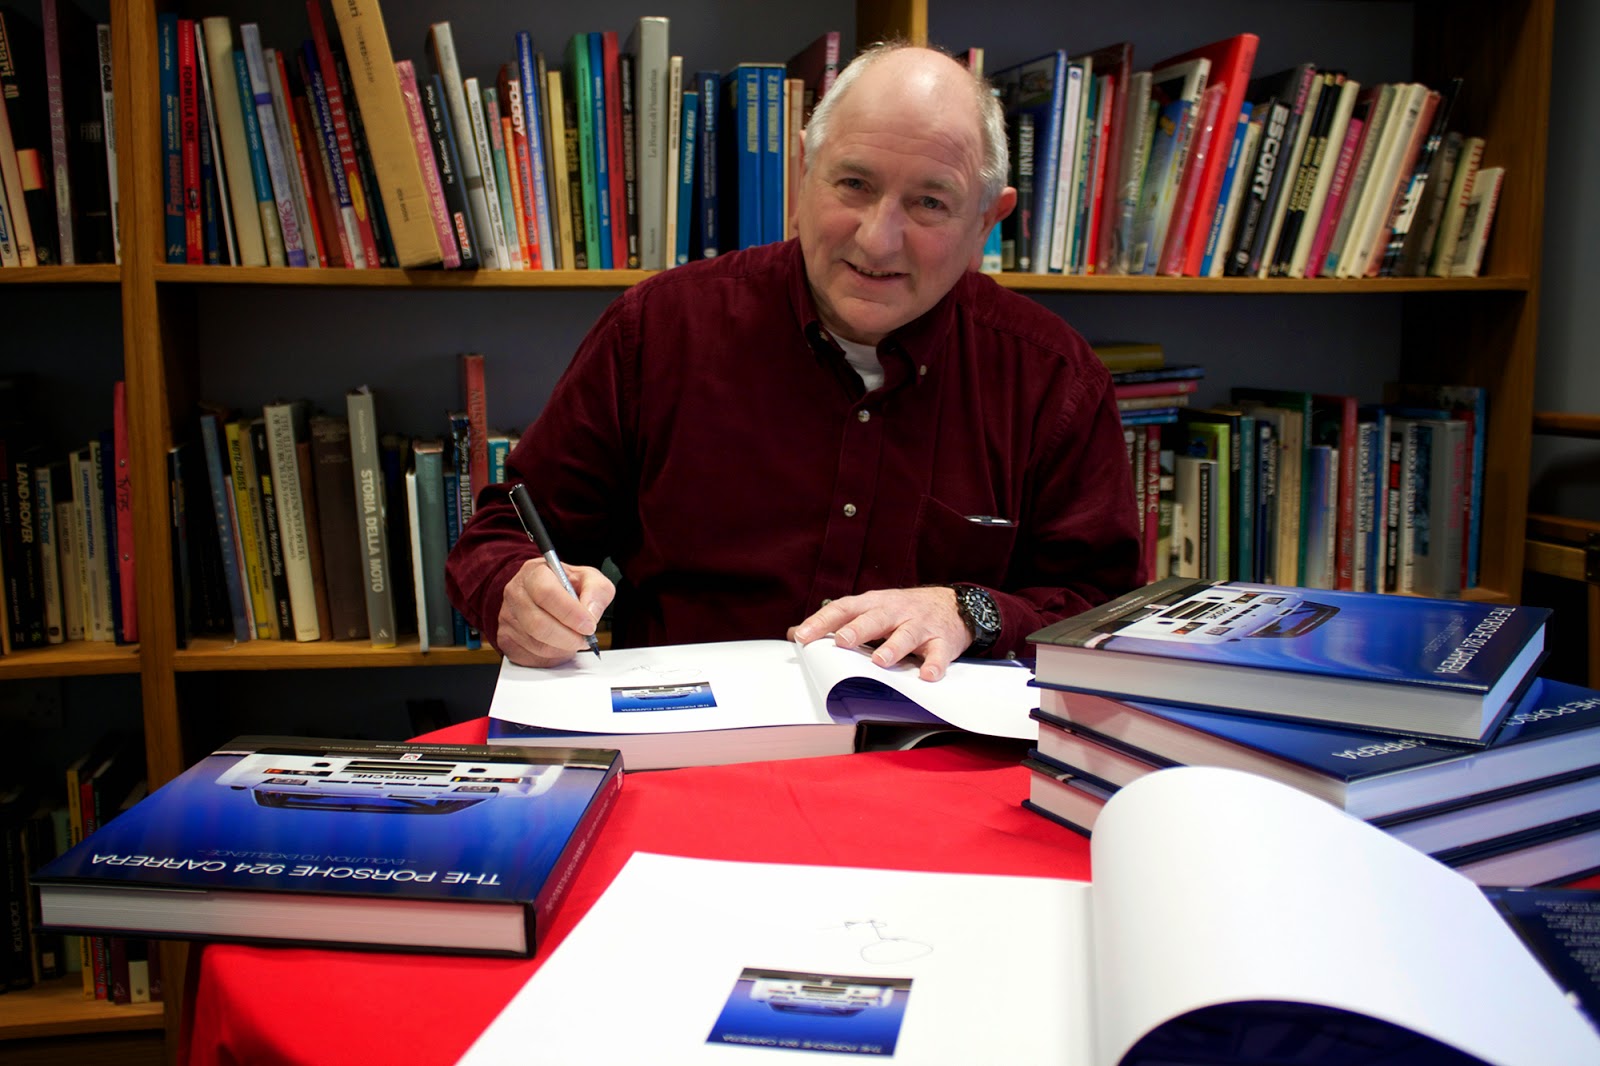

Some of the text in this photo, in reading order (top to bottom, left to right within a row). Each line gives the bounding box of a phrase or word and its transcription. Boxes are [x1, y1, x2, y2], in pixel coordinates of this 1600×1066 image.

[508, 78, 526, 136] FOGGY
[1251, 104, 1290, 200] ESCORT
[470, 389, 484, 463] MUSTANG
[359, 468, 384, 593] STORIA DELLA MOTO
[1487, 607, 1516, 618] THE
[1468, 615, 1508, 639] PORSCHE
[1460, 637, 1487, 649] 924
[1433, 647, 1479, 674] CARRERA
[352, 773, 428, 781] PORSCHE
[91, 853, 502, 886] THE PORSCHE 924 CARRERA
[210, 849, 406, 866] EVOLUTION TO EXCELLENCE
